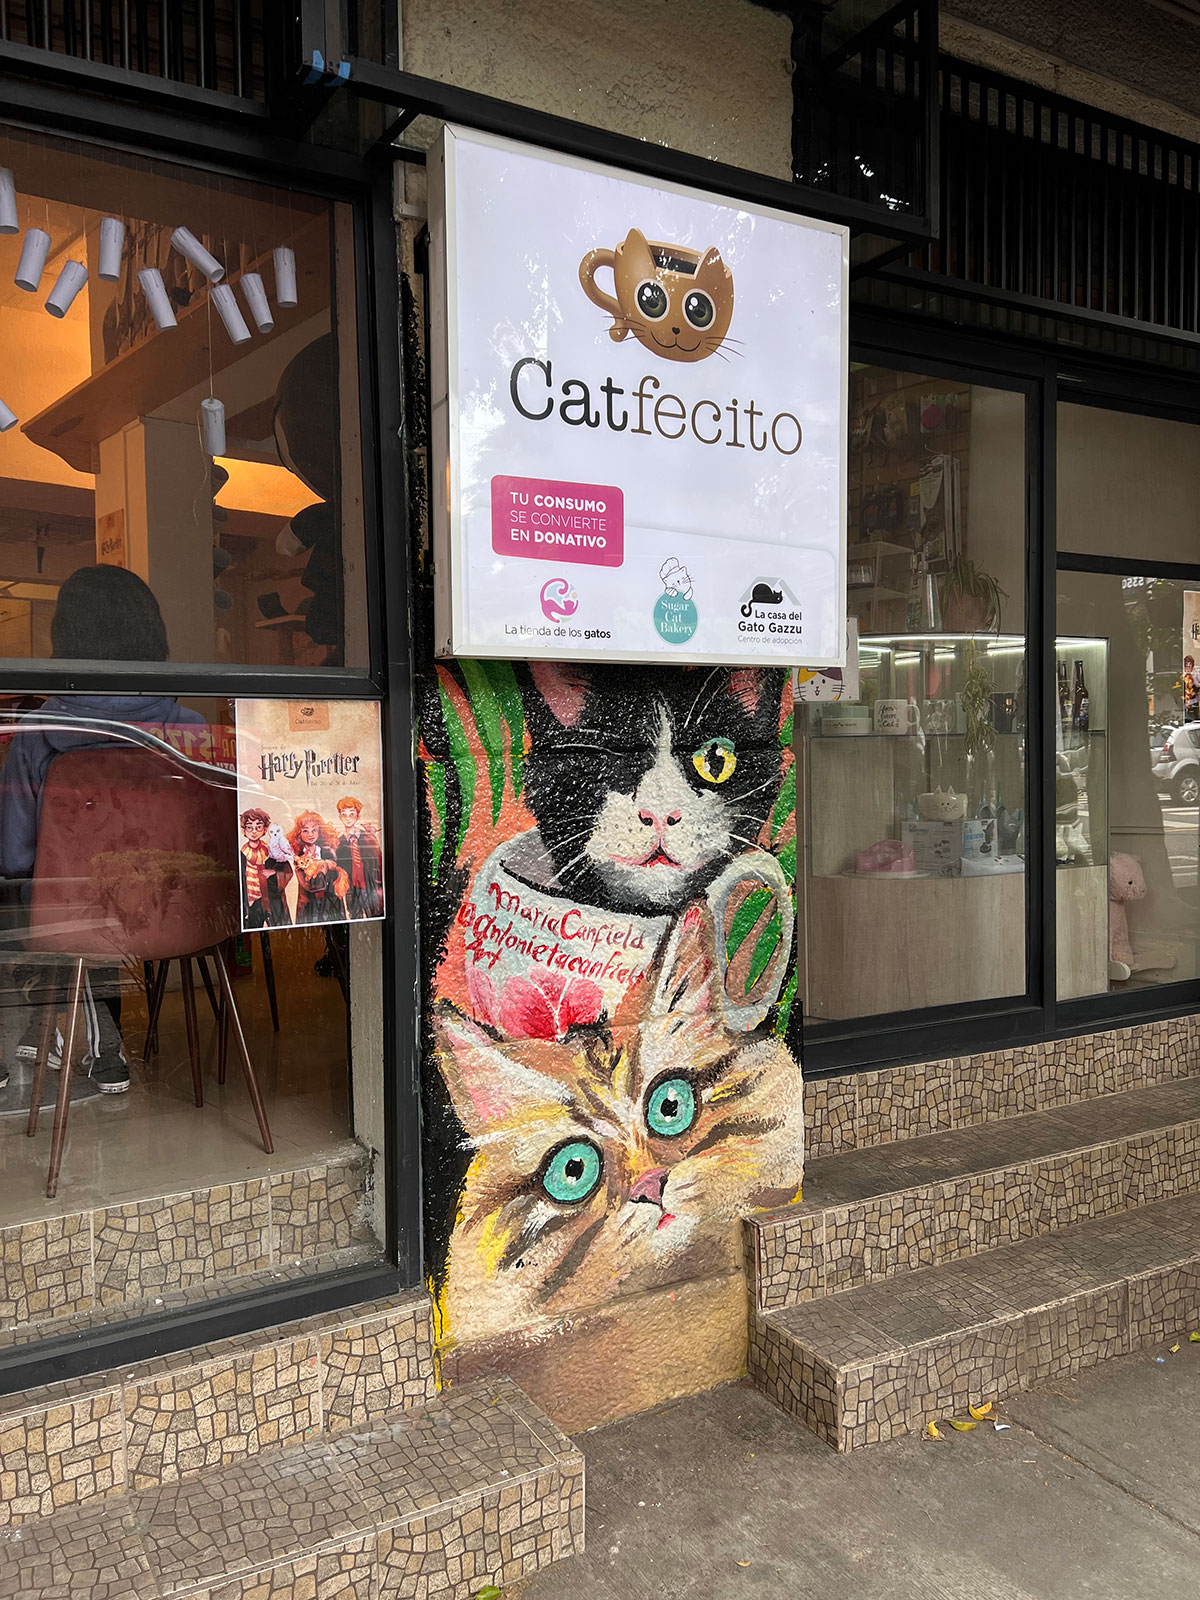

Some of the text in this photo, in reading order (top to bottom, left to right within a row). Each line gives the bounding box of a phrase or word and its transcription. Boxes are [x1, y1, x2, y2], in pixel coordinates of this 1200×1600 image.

[509, 357, 803, 455] Catfecito
[509, 491, 607, 513] TU CONSUMO
[509, 510, 607, 531] SE CONVIERTE
[510, 528, 607, 548] EN DONATIVO
[661, 600, 690, 612] Sugar
[664, 611, 683, 623] Cat
[754, 610, 802, 621] La casa del
[504, 624, 611, 640] La tienda de los gatos
[660, 622, 694, 636] Bakery
[737, 620, 802, 634] Gato Gazzu
[737, 634, 761, 643] Centro
[762, 635, 771, 644] de
[257, 748, 360, 788] Harry Purrtter
